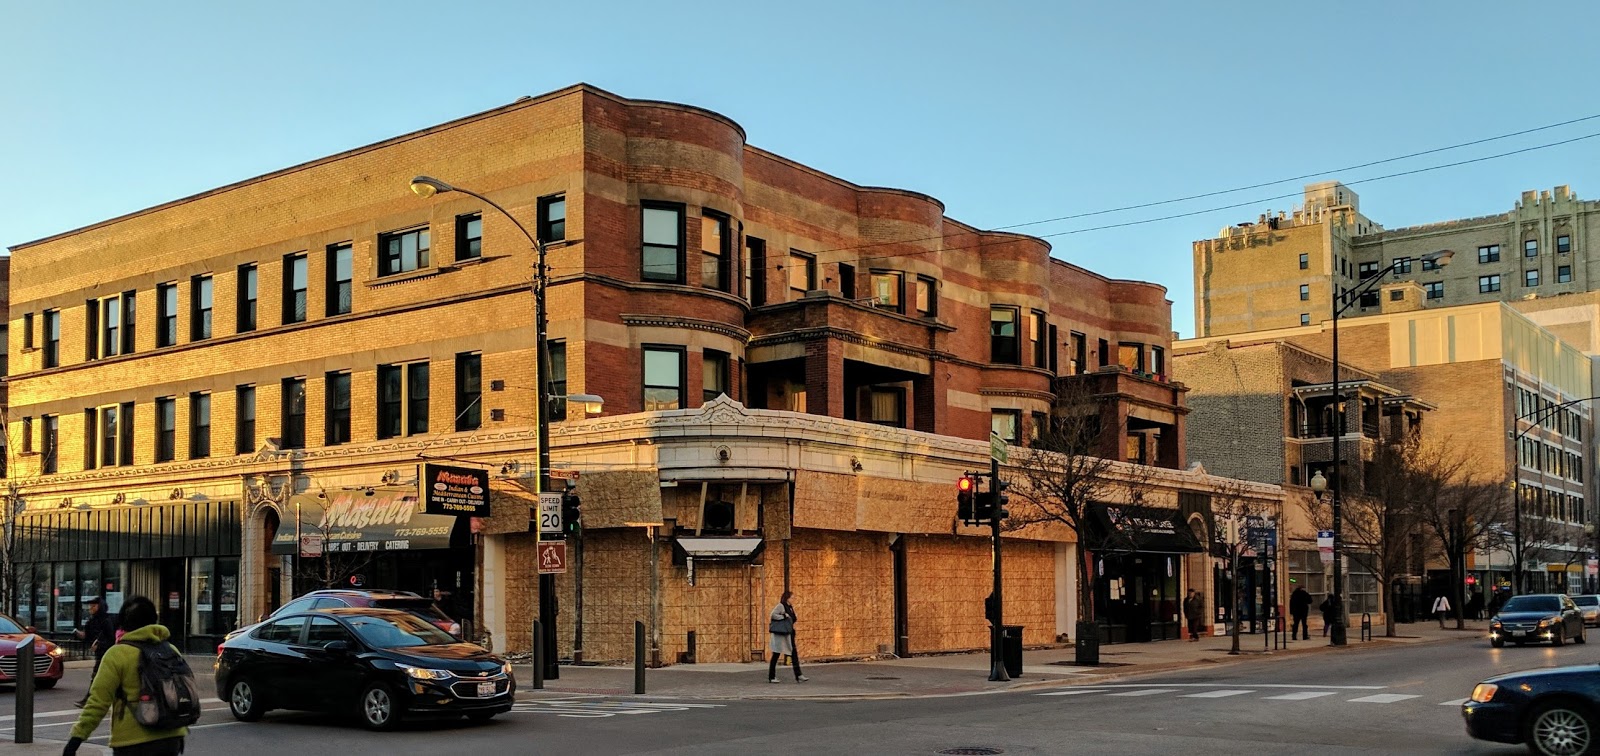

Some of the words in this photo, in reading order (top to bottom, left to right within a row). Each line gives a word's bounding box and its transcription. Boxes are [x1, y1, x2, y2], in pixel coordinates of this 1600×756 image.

[318, 493, 415, 528] Masala
[542, 514, 560, 528] 20
[394, 526, 449, 536] 773-769-5555
[341, 542, 352, 552] OUT
[356, 541, 379, 551] DELIVERY
[385, 540, 410, 550] CATERING
